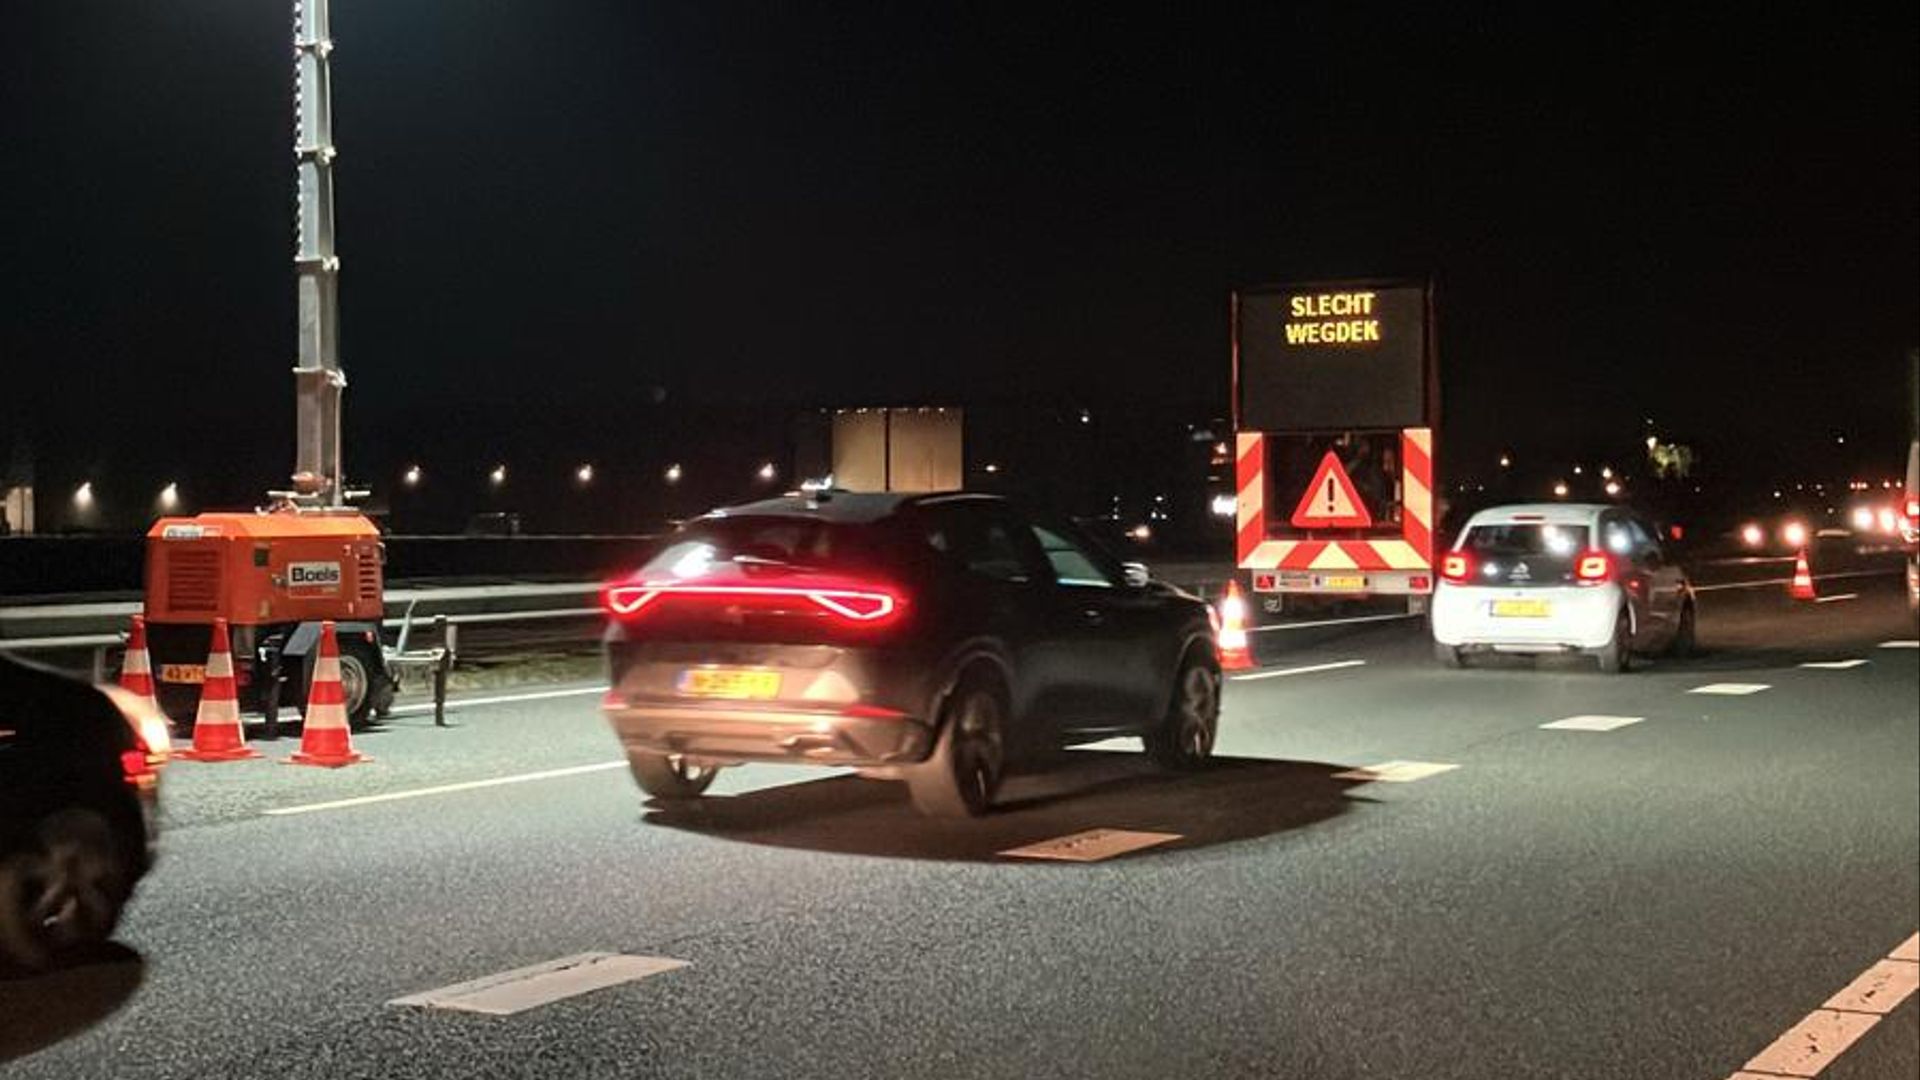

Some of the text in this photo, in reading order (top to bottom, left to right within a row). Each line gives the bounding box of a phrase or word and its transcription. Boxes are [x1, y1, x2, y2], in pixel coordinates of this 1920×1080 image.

[1291, 292, 1375, 316] SLECHT
[1285, 320, 1379, 344] WEGDEK
[292, 567, 339, 582] Boels
